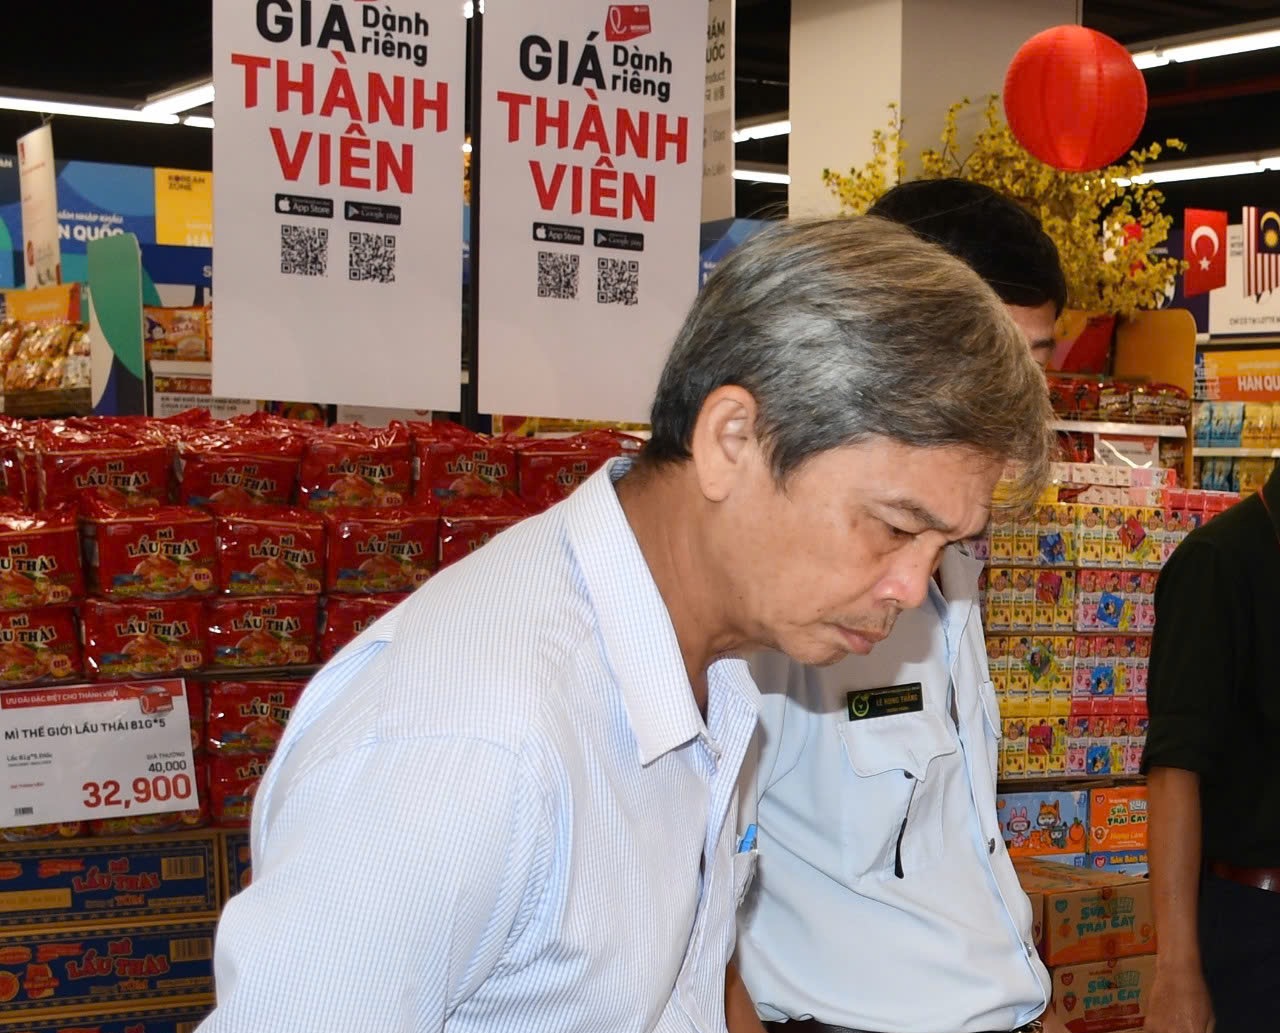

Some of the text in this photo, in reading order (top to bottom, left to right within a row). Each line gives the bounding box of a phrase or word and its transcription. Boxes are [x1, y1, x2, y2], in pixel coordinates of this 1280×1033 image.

[362, 4, 429, 36] Dành
[361, 32, 428, 67] riêng
[519, 31, 606, 90] GIÁ
[613, 44, 672, 74] Dành
[231, 50, 449, 133] THÀNH
[612, 71, 671, 104] riêng
[497, 88, 688, 165] THÀNH
[269, 123, 413, 194] VIÊN
[528, 155, 656, 222] VIÊN
[310, 204, 331, 215] Store
[5, 728, 19, 741] MÌ
[22, 726, 45, 738] THẾ
[47, 723, 72, 737] GIỚI
[148, 760, 187, 774] 40,000
[82, 773, 192, 809] 32,900
